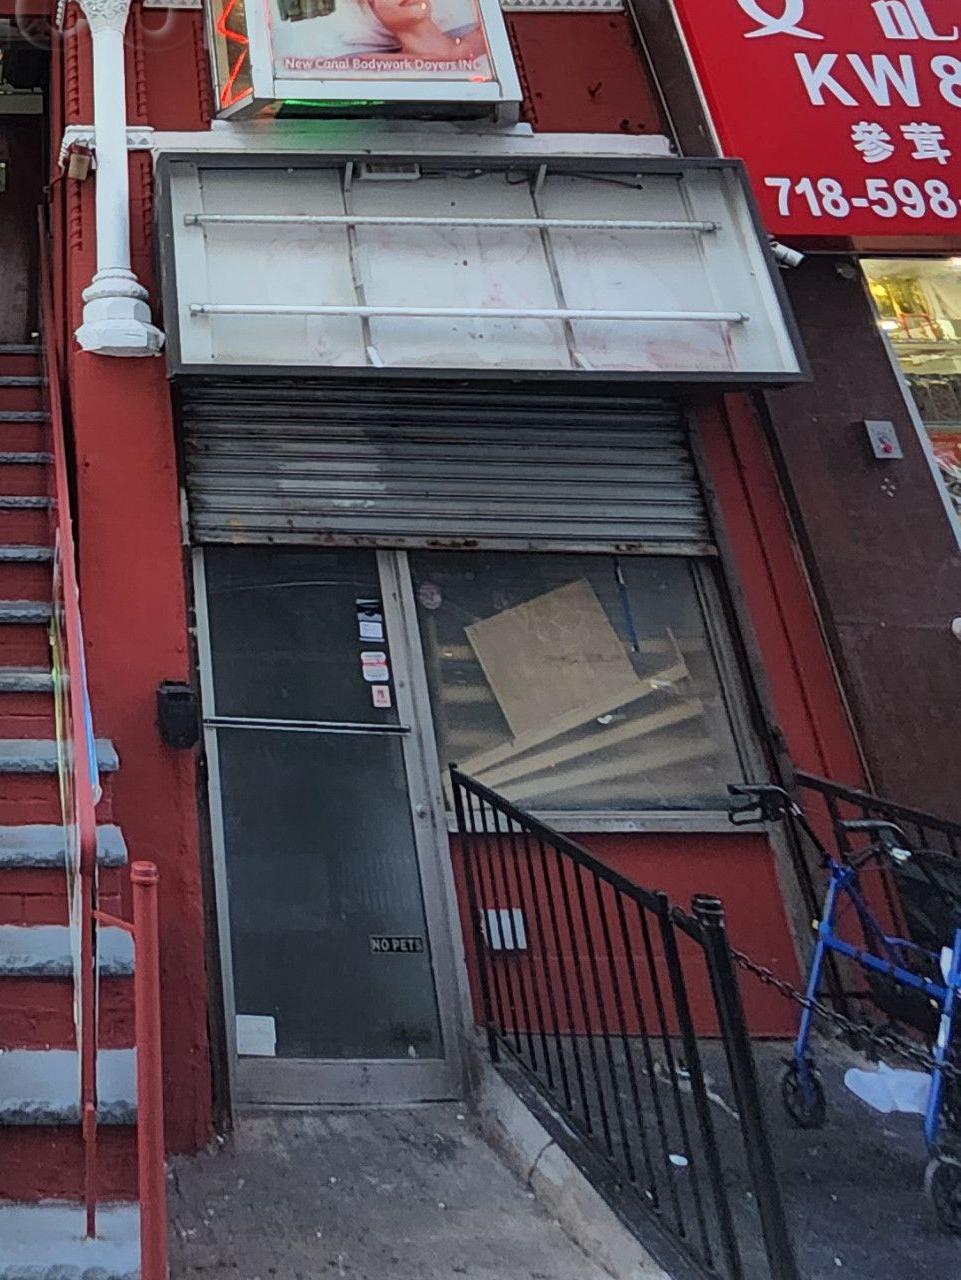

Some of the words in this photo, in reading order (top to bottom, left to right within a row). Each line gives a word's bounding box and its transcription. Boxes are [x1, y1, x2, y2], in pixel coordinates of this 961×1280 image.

[285, 58, 313, 70] New
[315, 58, 349, 70] Canal
[352, 59, 412, 71] Bodywork
[415, 59, 456, 72] Doyers
[764, 176, 961, 219] 718-598
[372, 938, 390, 951] NO
[391, 938, 423, 952] PETS
